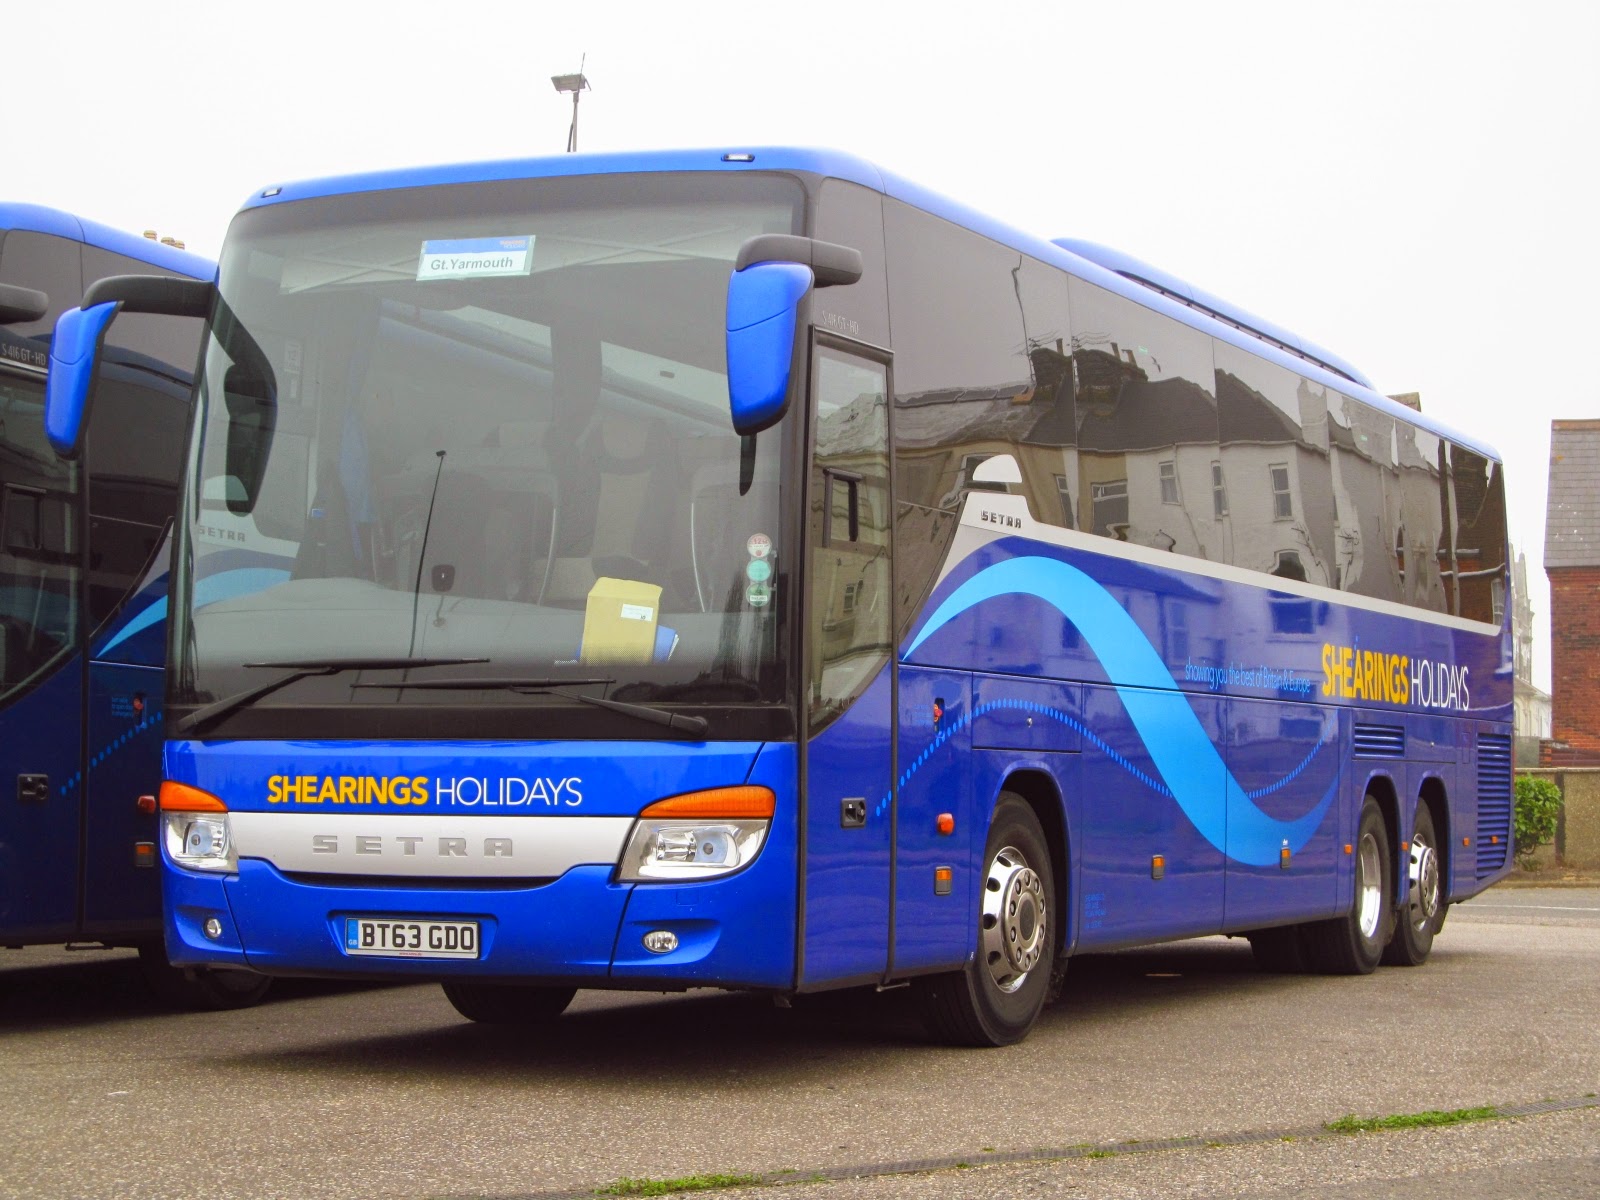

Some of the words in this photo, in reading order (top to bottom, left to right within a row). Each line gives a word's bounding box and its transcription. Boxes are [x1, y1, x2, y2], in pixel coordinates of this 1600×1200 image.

[430, 257, 513, 270] Gt.Yarmouth
[20, 347, 46, 366] GT-HD
[981, 510, 1022, 528] SETRA
[198, 525, 246, 542] SETRA
[1185, 656, 1214, 690] showing
[1214, 668, 1228, 690] you
[1229, 661, 1240, 685] the
[1240, 662, 1255, 687] best
[1255, 664, 1263, 688] of
[1263, 666, 1282, 689] Britain
[1283, 669, 1289, 691] &
[1289, 670, 1310, 698] Europe
[1321, 643, 1409, 705] SHEARINGS
[1411, 658, 1470, 712] HOLIDAYS
[267, 774, 429, 805] SHEARINGS
[436, 777, 583, 806] HOLIDAYS
[312, 835, 514, 858] SETRA
[361, 922, 422, 949] BT63
[428, 925, 474, 950] GDO
